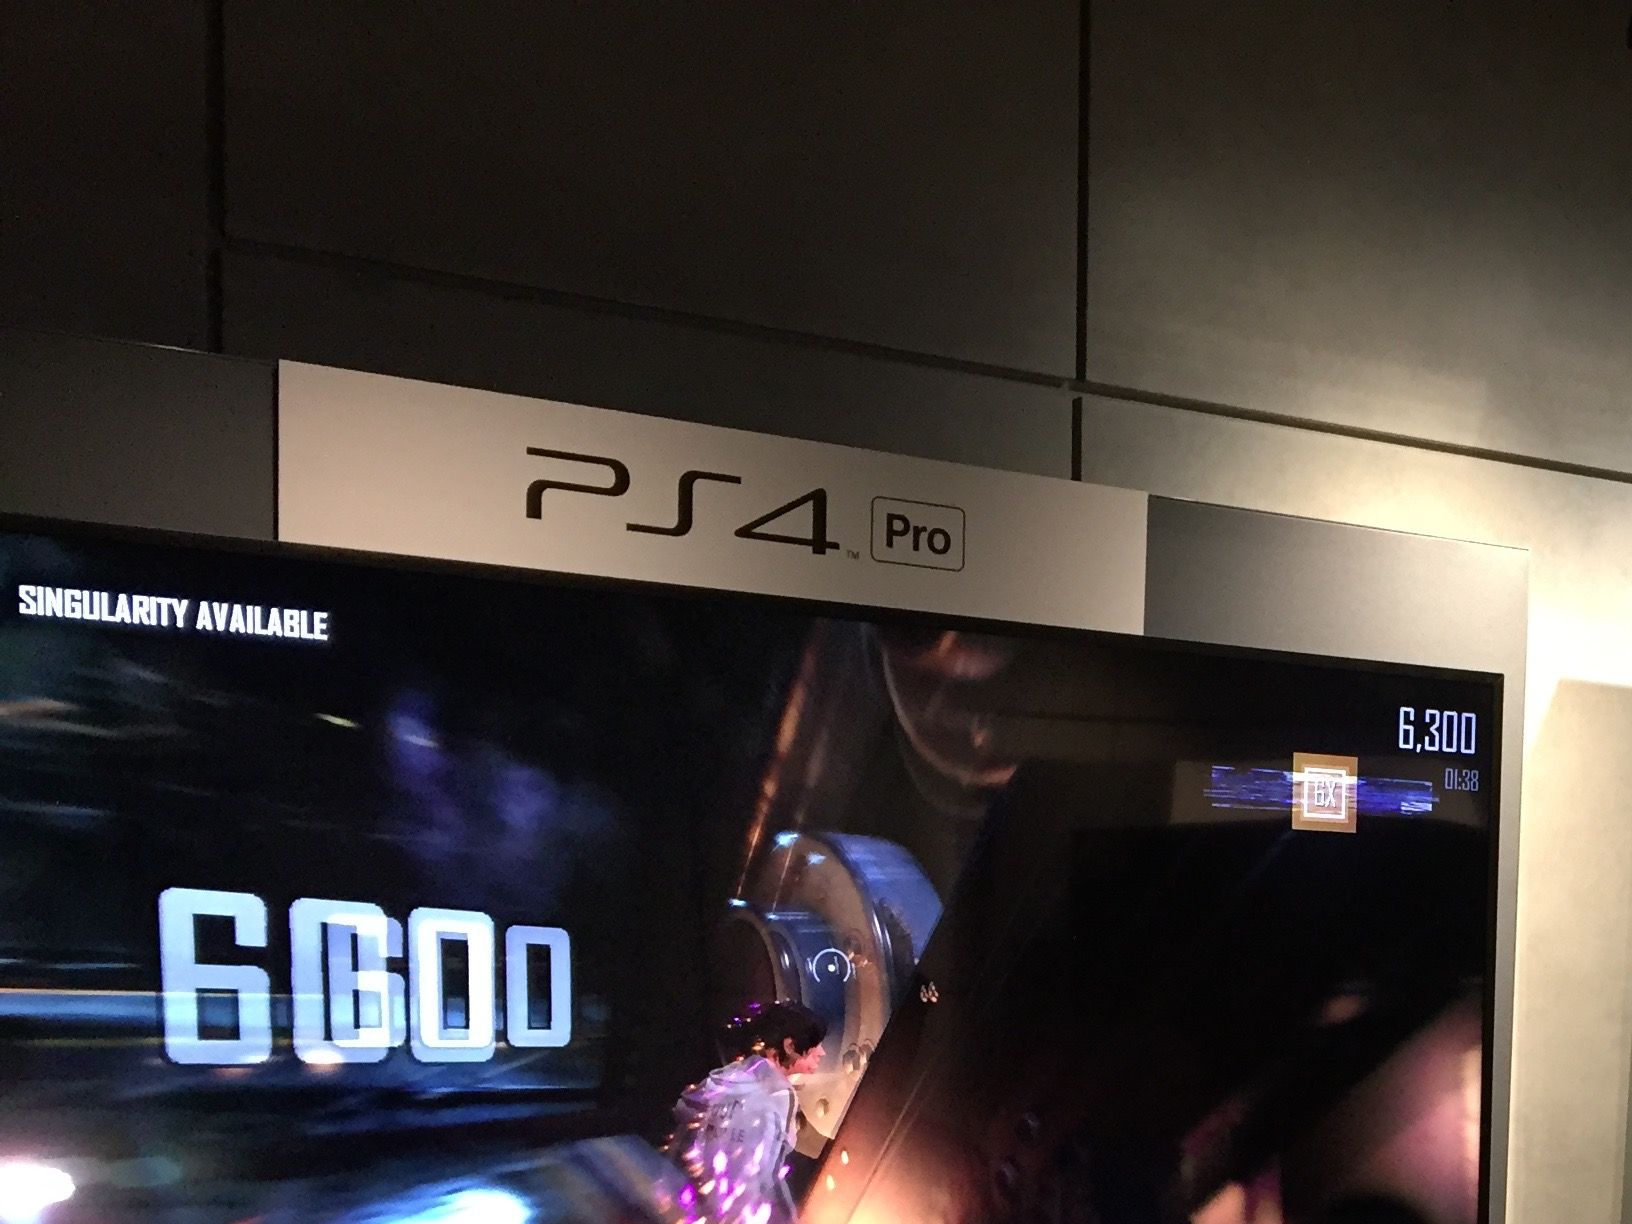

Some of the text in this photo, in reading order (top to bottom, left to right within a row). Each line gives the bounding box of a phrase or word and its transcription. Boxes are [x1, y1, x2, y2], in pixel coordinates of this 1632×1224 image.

[526, 446, 841, 556] PS4
[885, 512, 952, 556] Pro
[18, 584, 329, 641] SINGULARITY AVAILABLE
[1398, 706, 1477, 755] 6,300
[1444, 767, 1479, 792] 01:38
